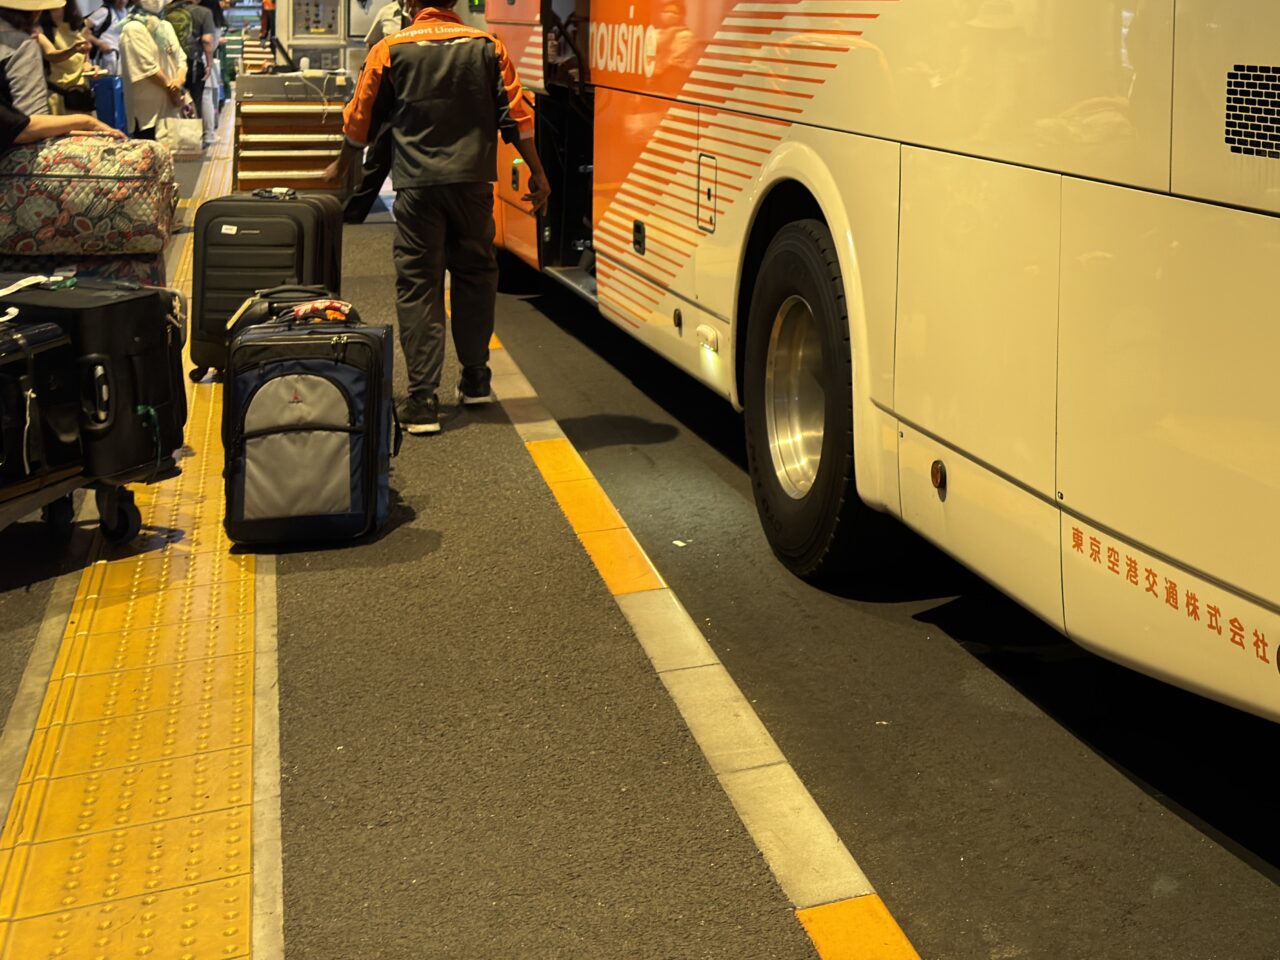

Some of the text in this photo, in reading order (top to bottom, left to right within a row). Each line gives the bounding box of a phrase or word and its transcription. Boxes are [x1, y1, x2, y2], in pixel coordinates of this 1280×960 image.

[1071, 526, 1270, 665] 東京空港交通株式会社
